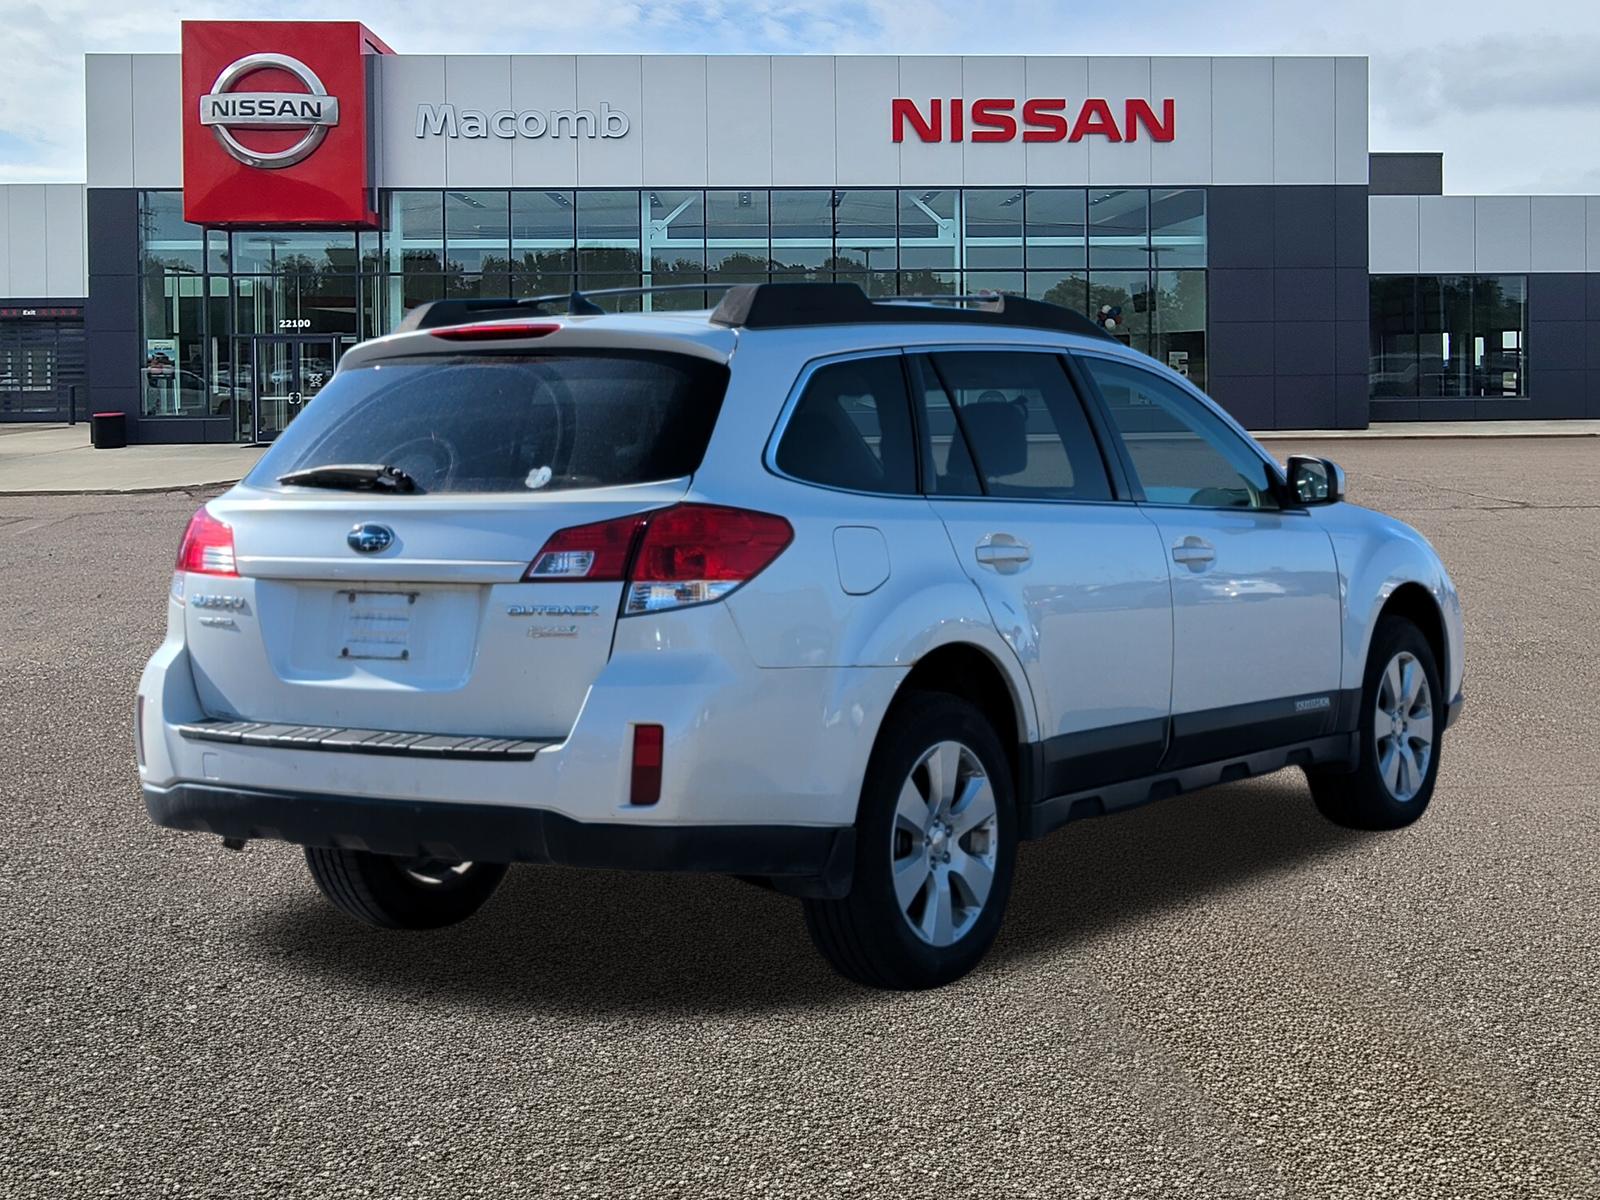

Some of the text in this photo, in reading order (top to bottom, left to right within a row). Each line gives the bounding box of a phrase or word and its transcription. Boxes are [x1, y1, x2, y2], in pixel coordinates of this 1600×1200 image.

[211, 100, 322, 118] NISSAN
[415, 102, 630, 139] Macomb
[892, 98, 1175, 143] NISSAN
[279, 319, 311, 329] 22100
[507, 604, 600, 617] OUTBACK
